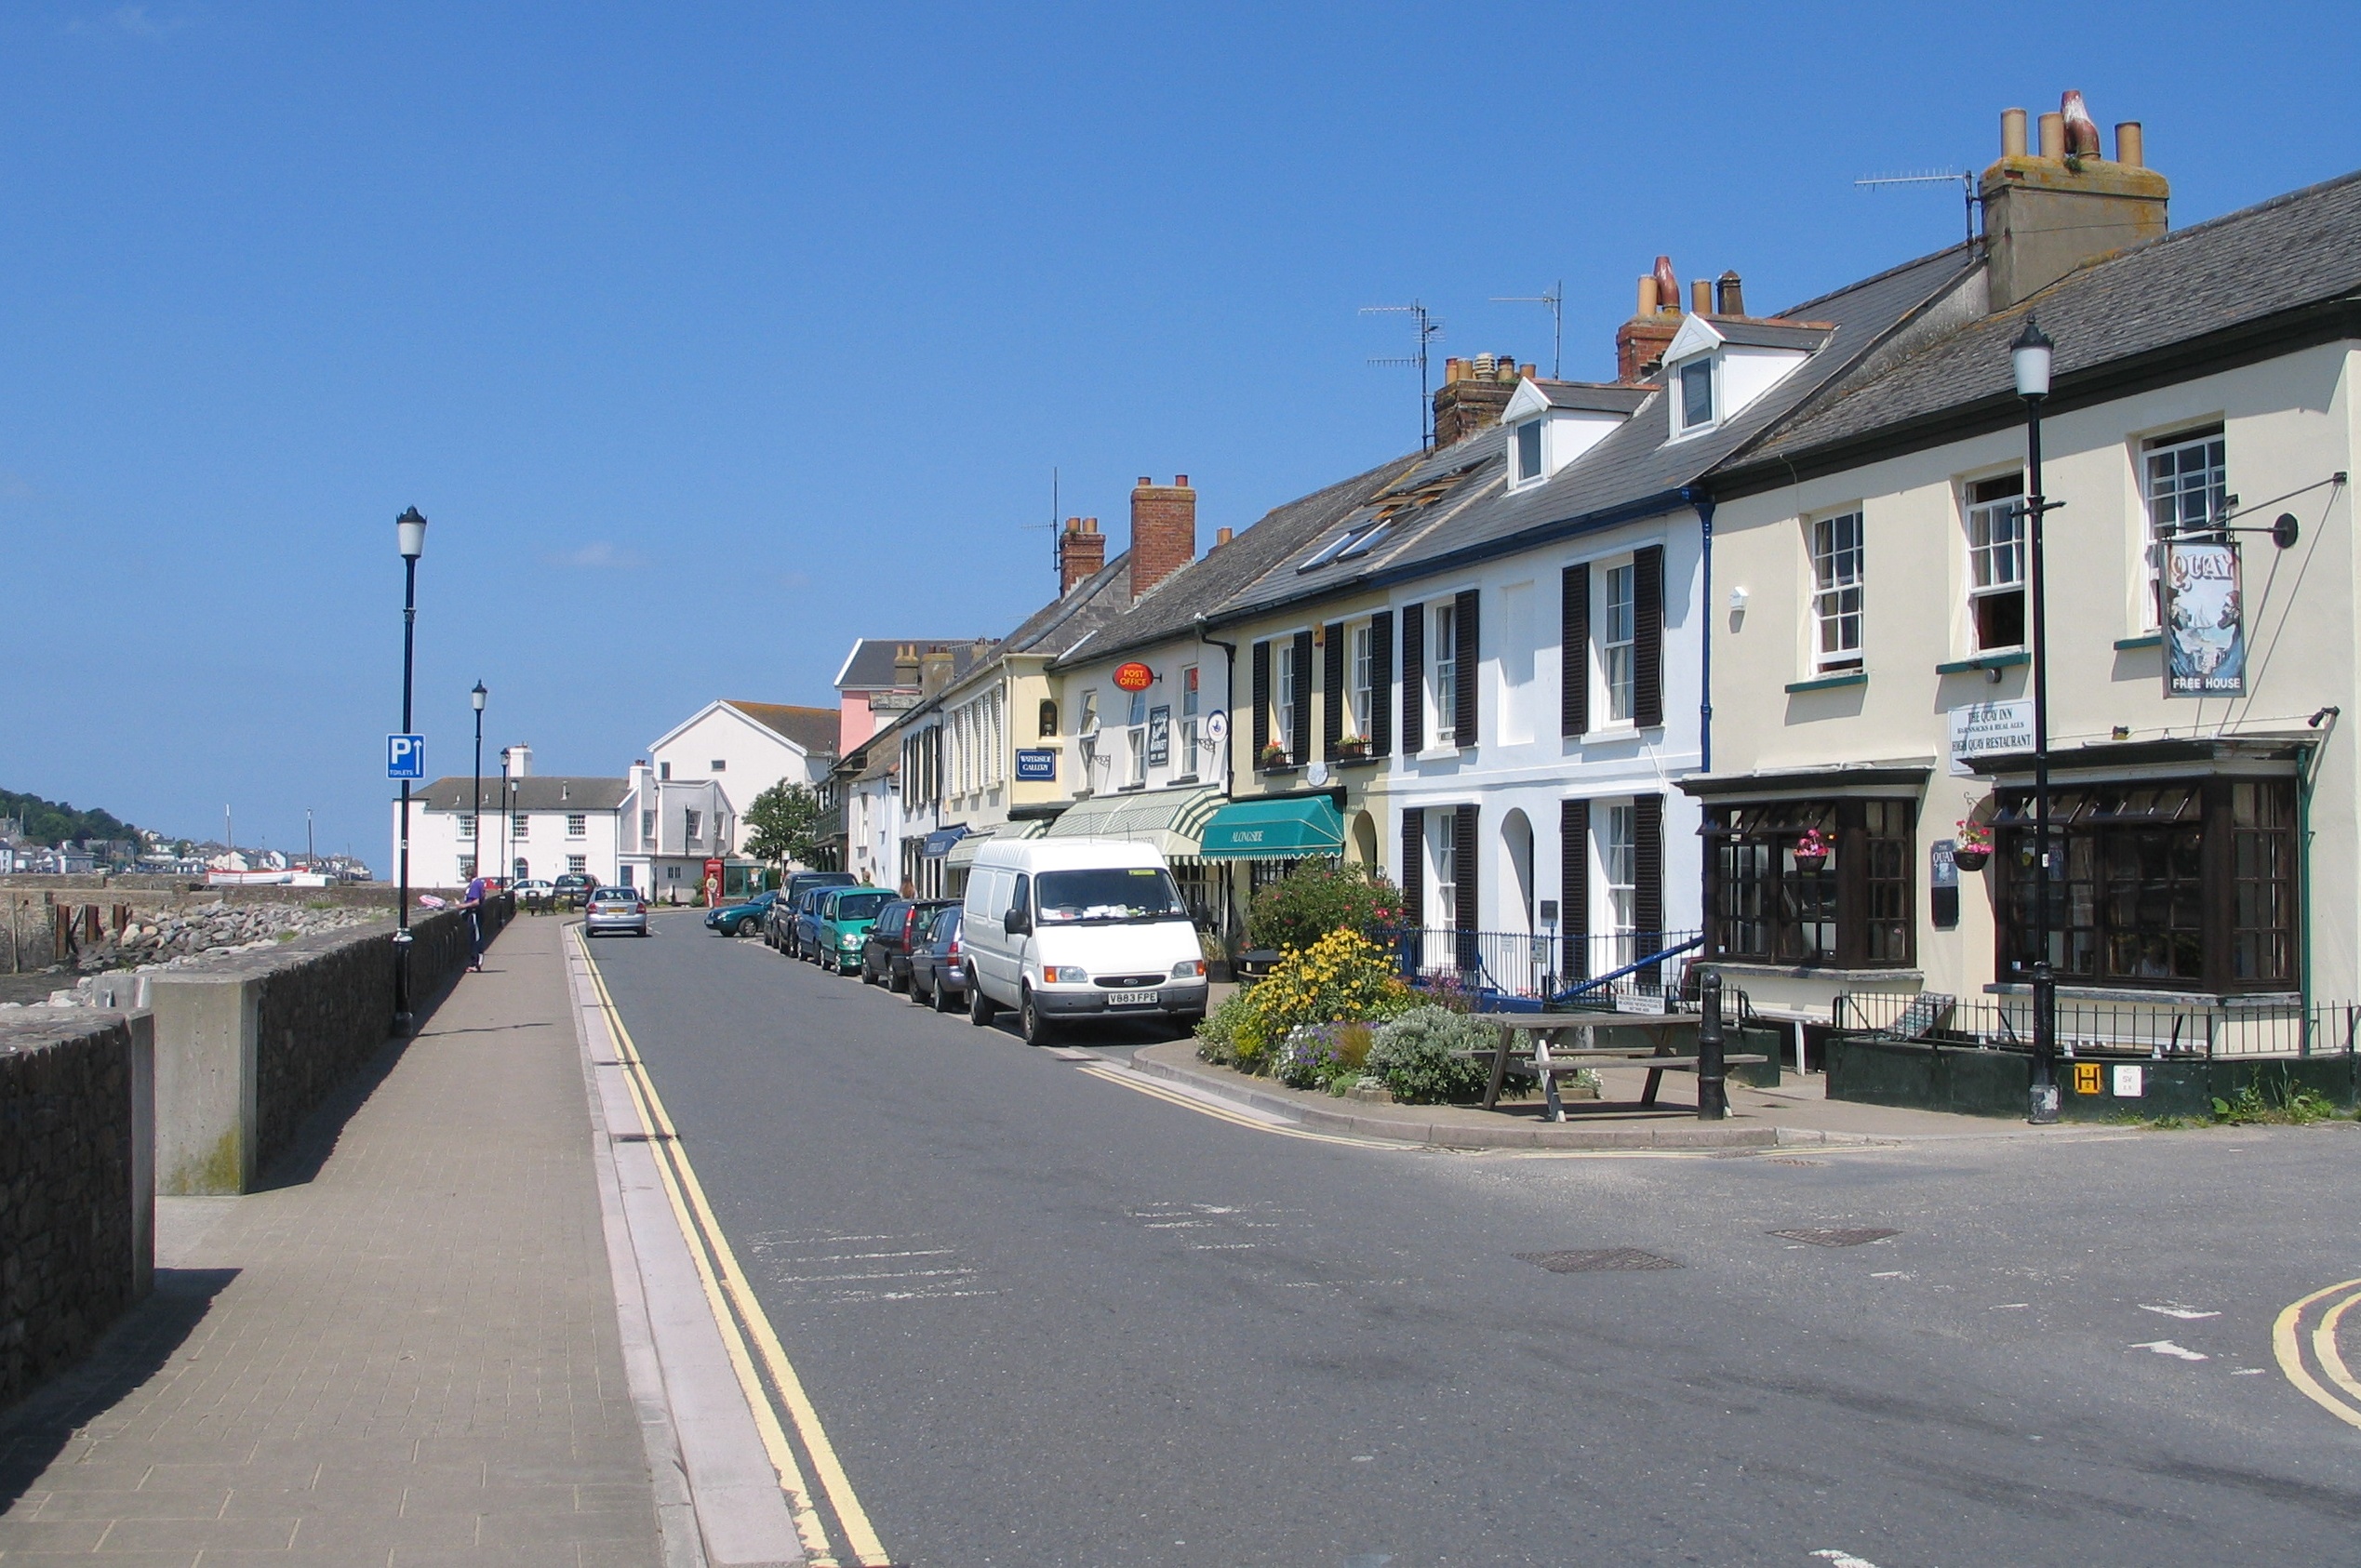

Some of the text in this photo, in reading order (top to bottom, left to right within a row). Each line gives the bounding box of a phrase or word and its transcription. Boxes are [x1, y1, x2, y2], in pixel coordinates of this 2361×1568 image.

[2170, 553, 2234, 592] QUAY
[1123, 669, 1145, 678] POST
[1119, 677, 1147, 686] OFFICE
[2173, 677, 2242, 689] FREE HOUSE
[1968, 708, 2013, 724] THE QUAY INN
[1994, 723, 2009, 731] REAL
[1968, 737, 1984, 751] QUAY
[1985, 734, 2032, 750] RESTAURANT
[391, 737, 412, 764] P
[1231, 831, 1264, 843] ALONGSIDE
[1137, 991, 1156, 1003] FPE
[2077, 1067, 2098, 1090] H
